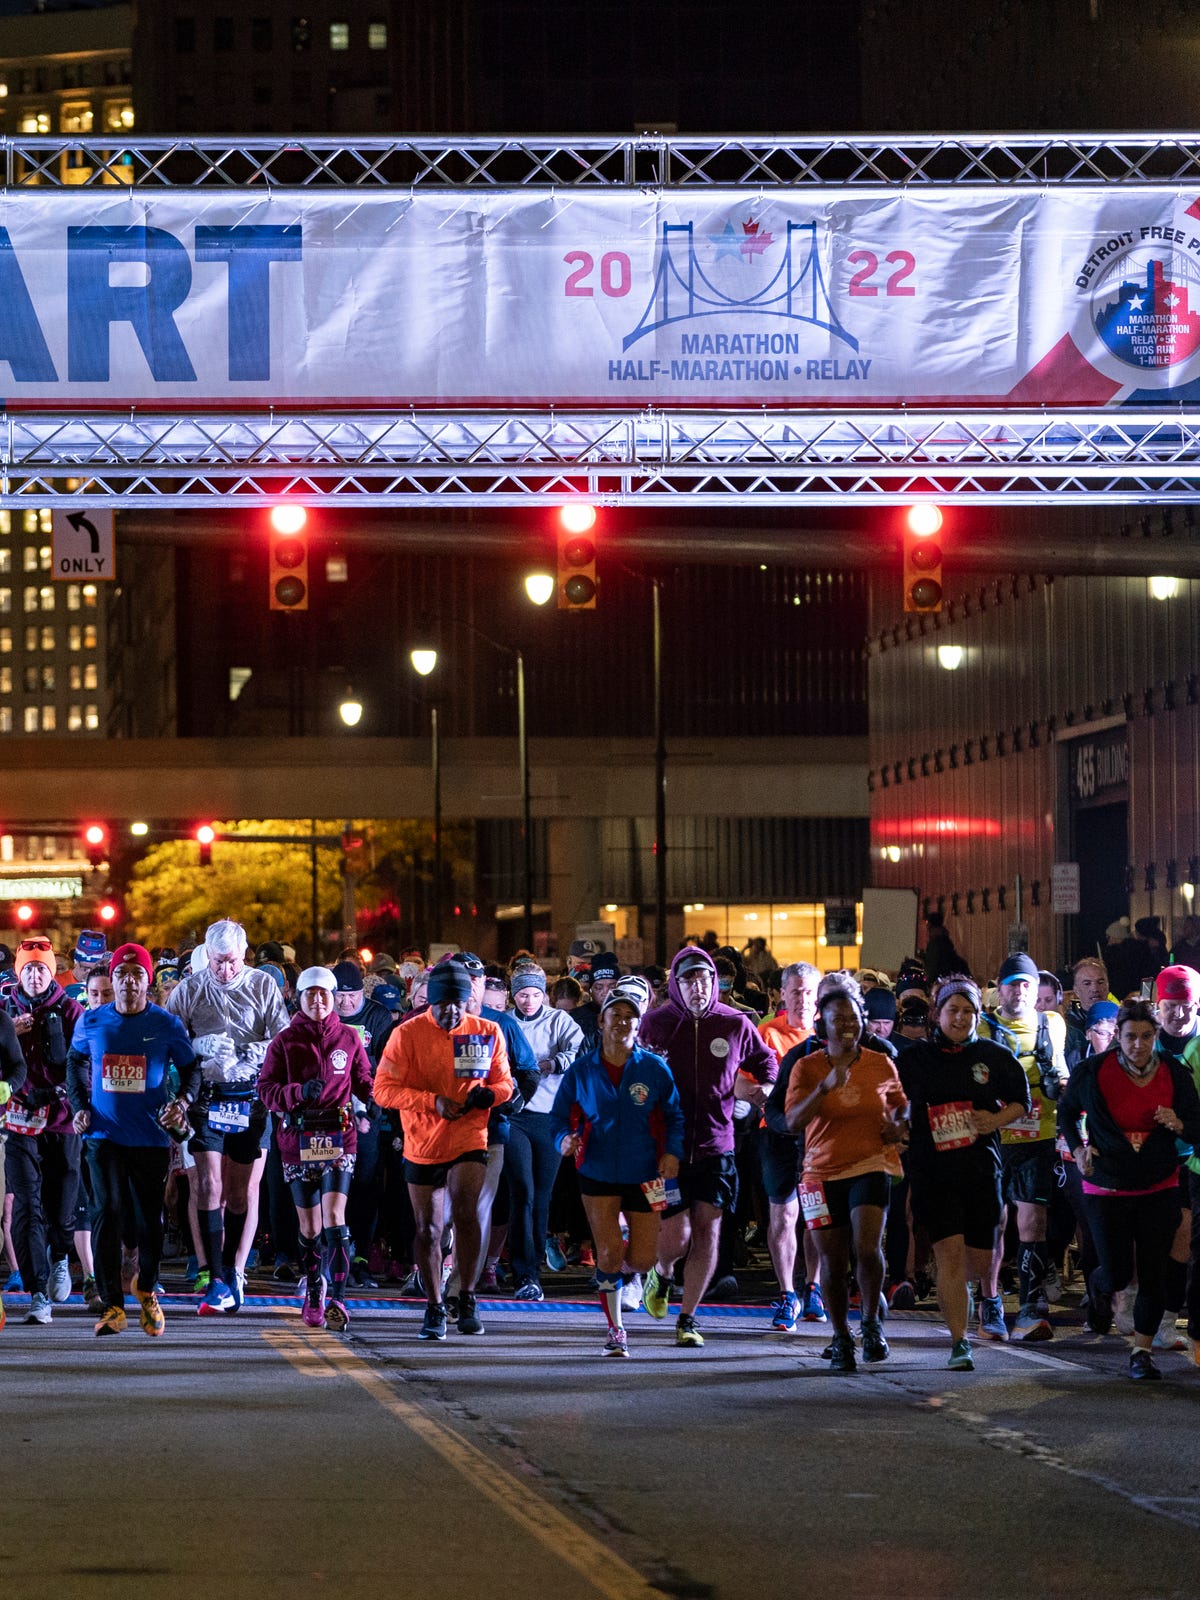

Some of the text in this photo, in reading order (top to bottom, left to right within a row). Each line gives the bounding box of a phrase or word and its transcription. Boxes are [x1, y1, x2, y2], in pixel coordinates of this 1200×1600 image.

[1075, 230, 1134, 289] DETROIT
[1140, 226, 1186, 244] FREE
[563, 250, 915, 298] 20 22
[1129, 314, 1178, 324] MARATHON
[1116, 325, 1190, 335] HALF-MARATHON
[681, 333, 799, 354] MARATHON
[1131, 335, 1177, 345] RELAY 5K
[1133, 345, 1175, 355] KIDS RUN
[1139, 355, 1170, 365] 1-MILE
[608, 359, 872, 381] HALF-MARATHON RELAY
[61, 558, 105, 573] ONLY
[1077, 742, 1129, 799] 455 BUILDING
[460, 1044, 489, 1057] 1009
[105, 1065, 144, 1079] 16128
[310, 1136, 333, 1149] 976
